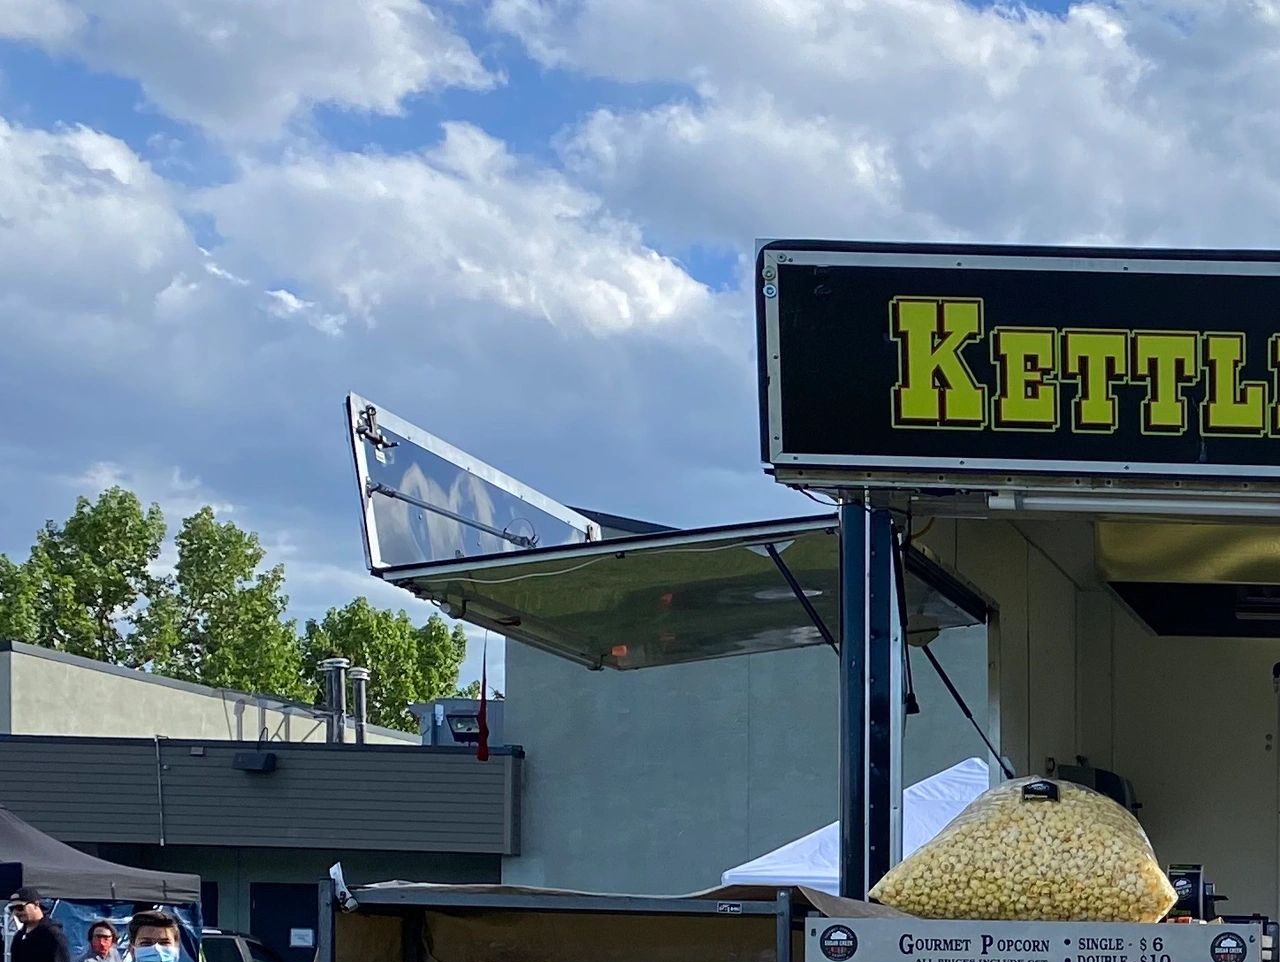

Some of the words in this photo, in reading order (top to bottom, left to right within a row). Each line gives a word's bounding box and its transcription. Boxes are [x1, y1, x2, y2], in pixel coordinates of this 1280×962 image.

[899, 934, 971, 955] GOURMET
[981, 935, 1049, 955] POPCORN
[1079, 938, 1124, 951] SINGLE
